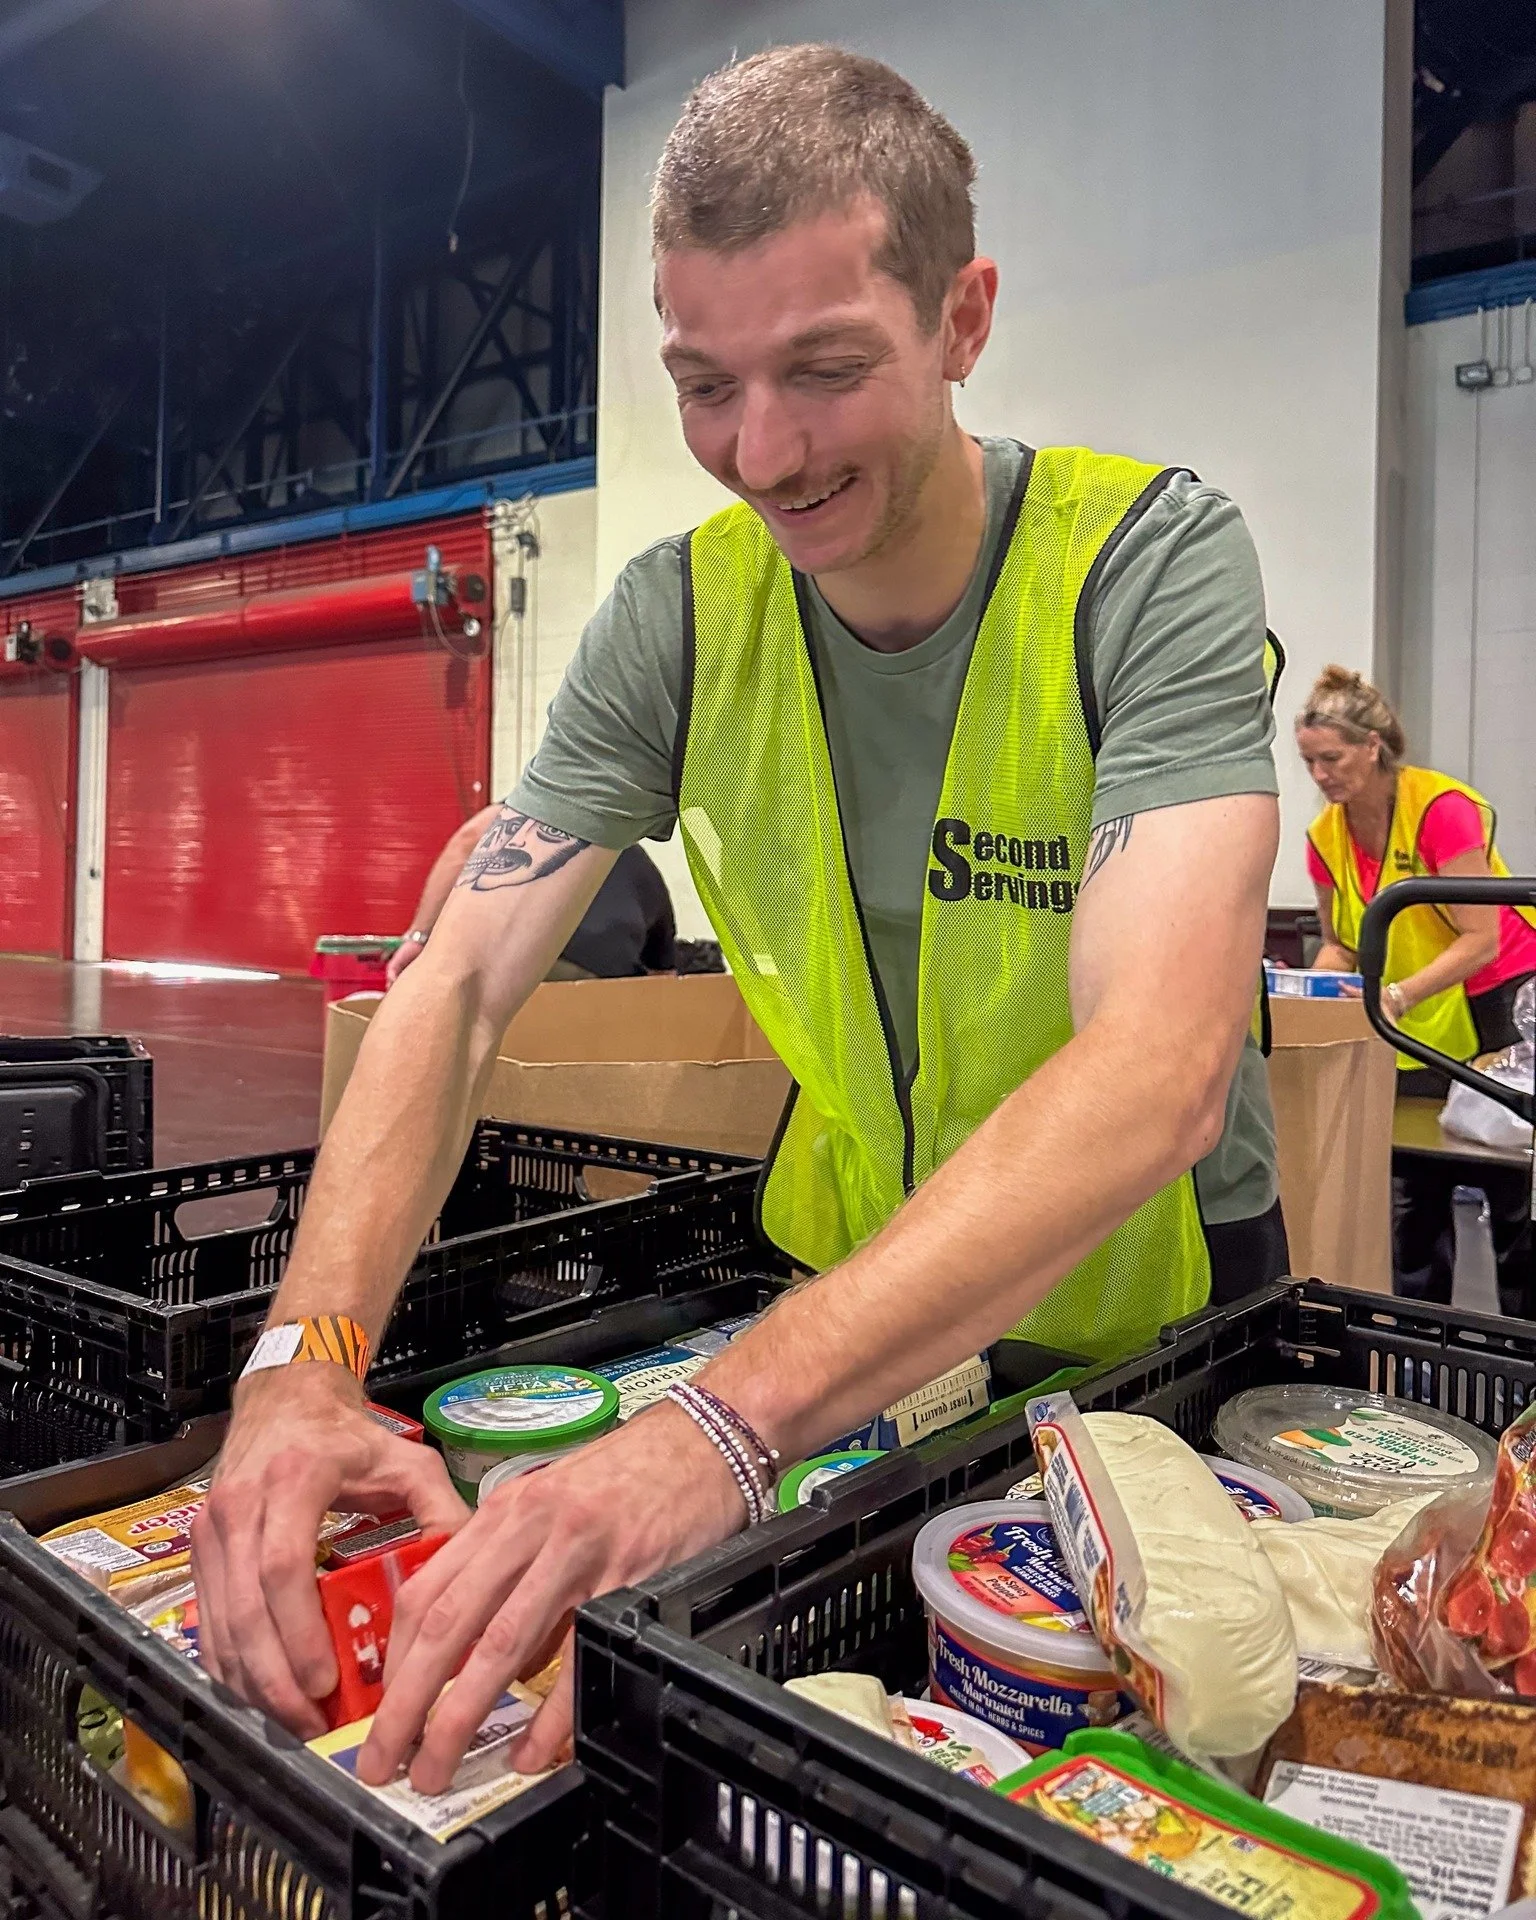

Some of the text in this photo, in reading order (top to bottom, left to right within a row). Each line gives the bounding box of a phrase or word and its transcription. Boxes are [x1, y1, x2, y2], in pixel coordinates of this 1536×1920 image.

[489, 1381, 547, 1393] FETA
[920, 1402, 949, 1423] QUALITY
[949, 1395, 967, 1411] FIRST
[1344, 1430, 1438, 1467] CARAMELIZED
[1376, 1436, 1419, 1453] ONION
[1003, 1525, 1053, 1560] Fresh
[986, 1578, 1019, 1599] Pepper
[1006, 1579, 1031, 1598] Spicy
[1036, 1582, 1060, 1598] SPICES
[938, 1635, 1073, 1717] Fresh Mozzarella
[961, 1679, 1025, 1722] Marinated
[949, 1685, 967, 1704] CHEESE
[988, 1711, 1010, 1730] HERBS
[1018, 1725, 1045, 1740] SPICES
